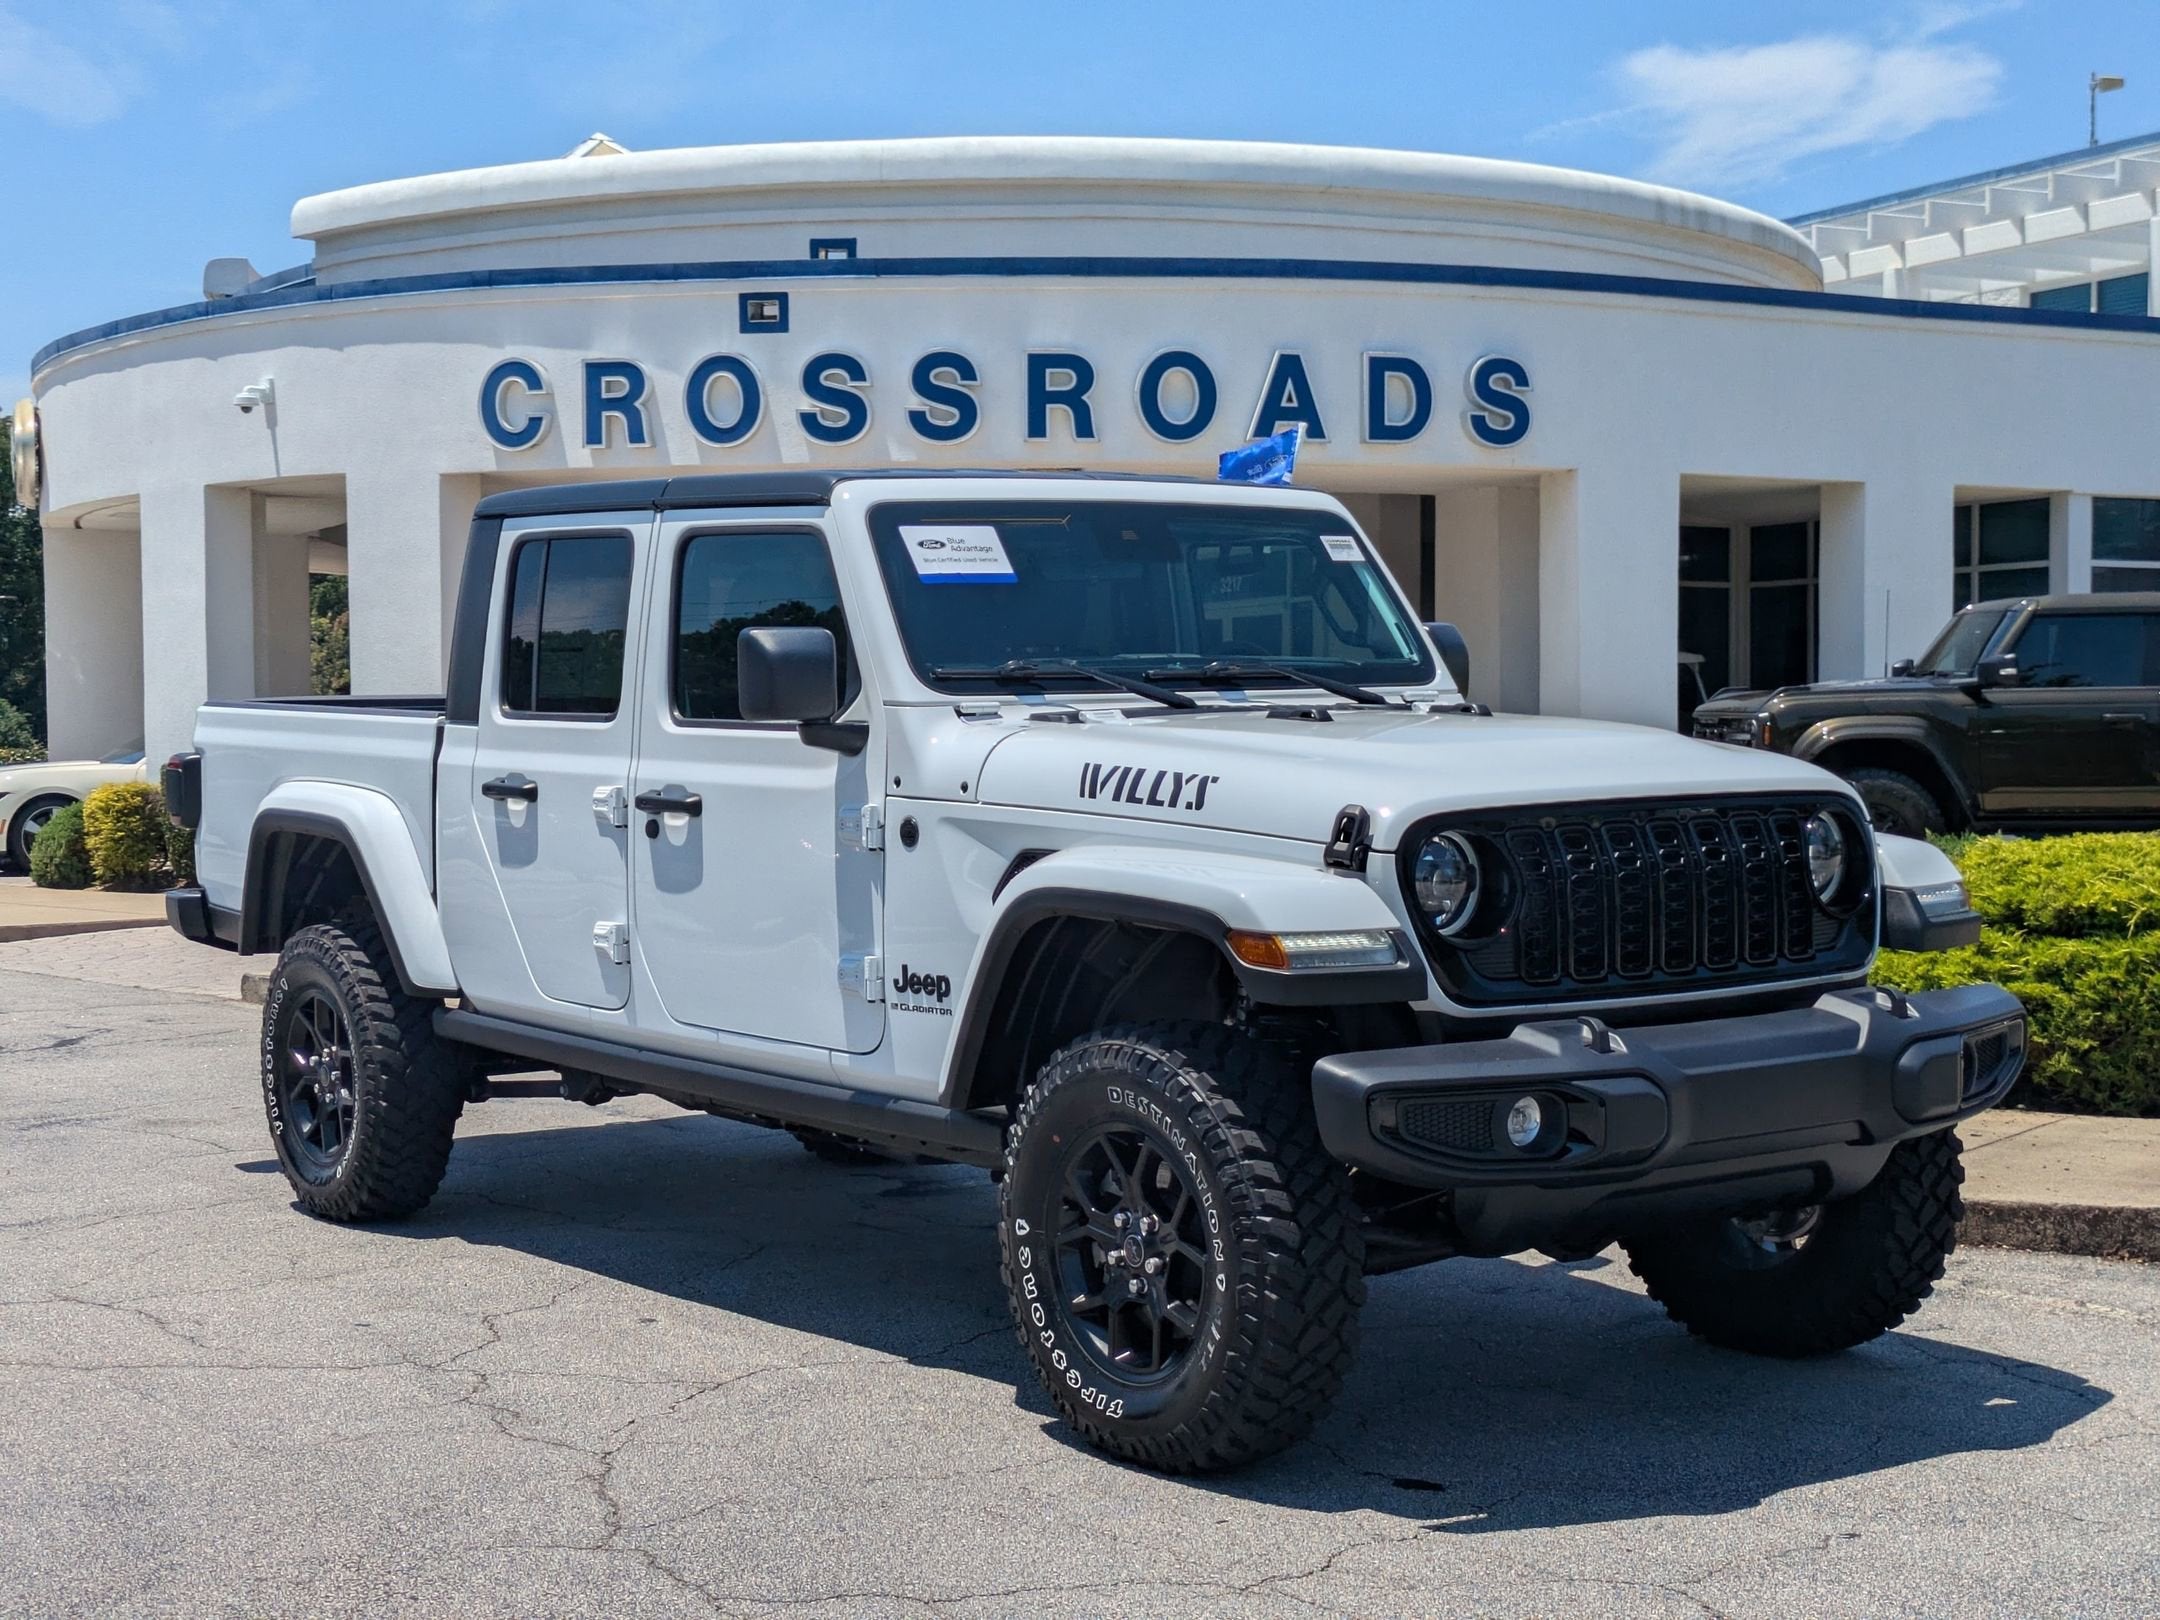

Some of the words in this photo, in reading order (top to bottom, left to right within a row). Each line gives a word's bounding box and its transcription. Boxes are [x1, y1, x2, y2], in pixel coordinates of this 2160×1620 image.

[479, 349, 1534, 450] CROSSROADS
[947, 537, 966, 545] Blue
[951, 545, 993, 553] Advantage
[1079, 762, 1221, 812] WILLYS
[893, 964, 951, 1003] Jeep
[900, 1003, 953, 1016] GLADIATOR
[1106, 1085, 1225, 1262] DESTINATION
